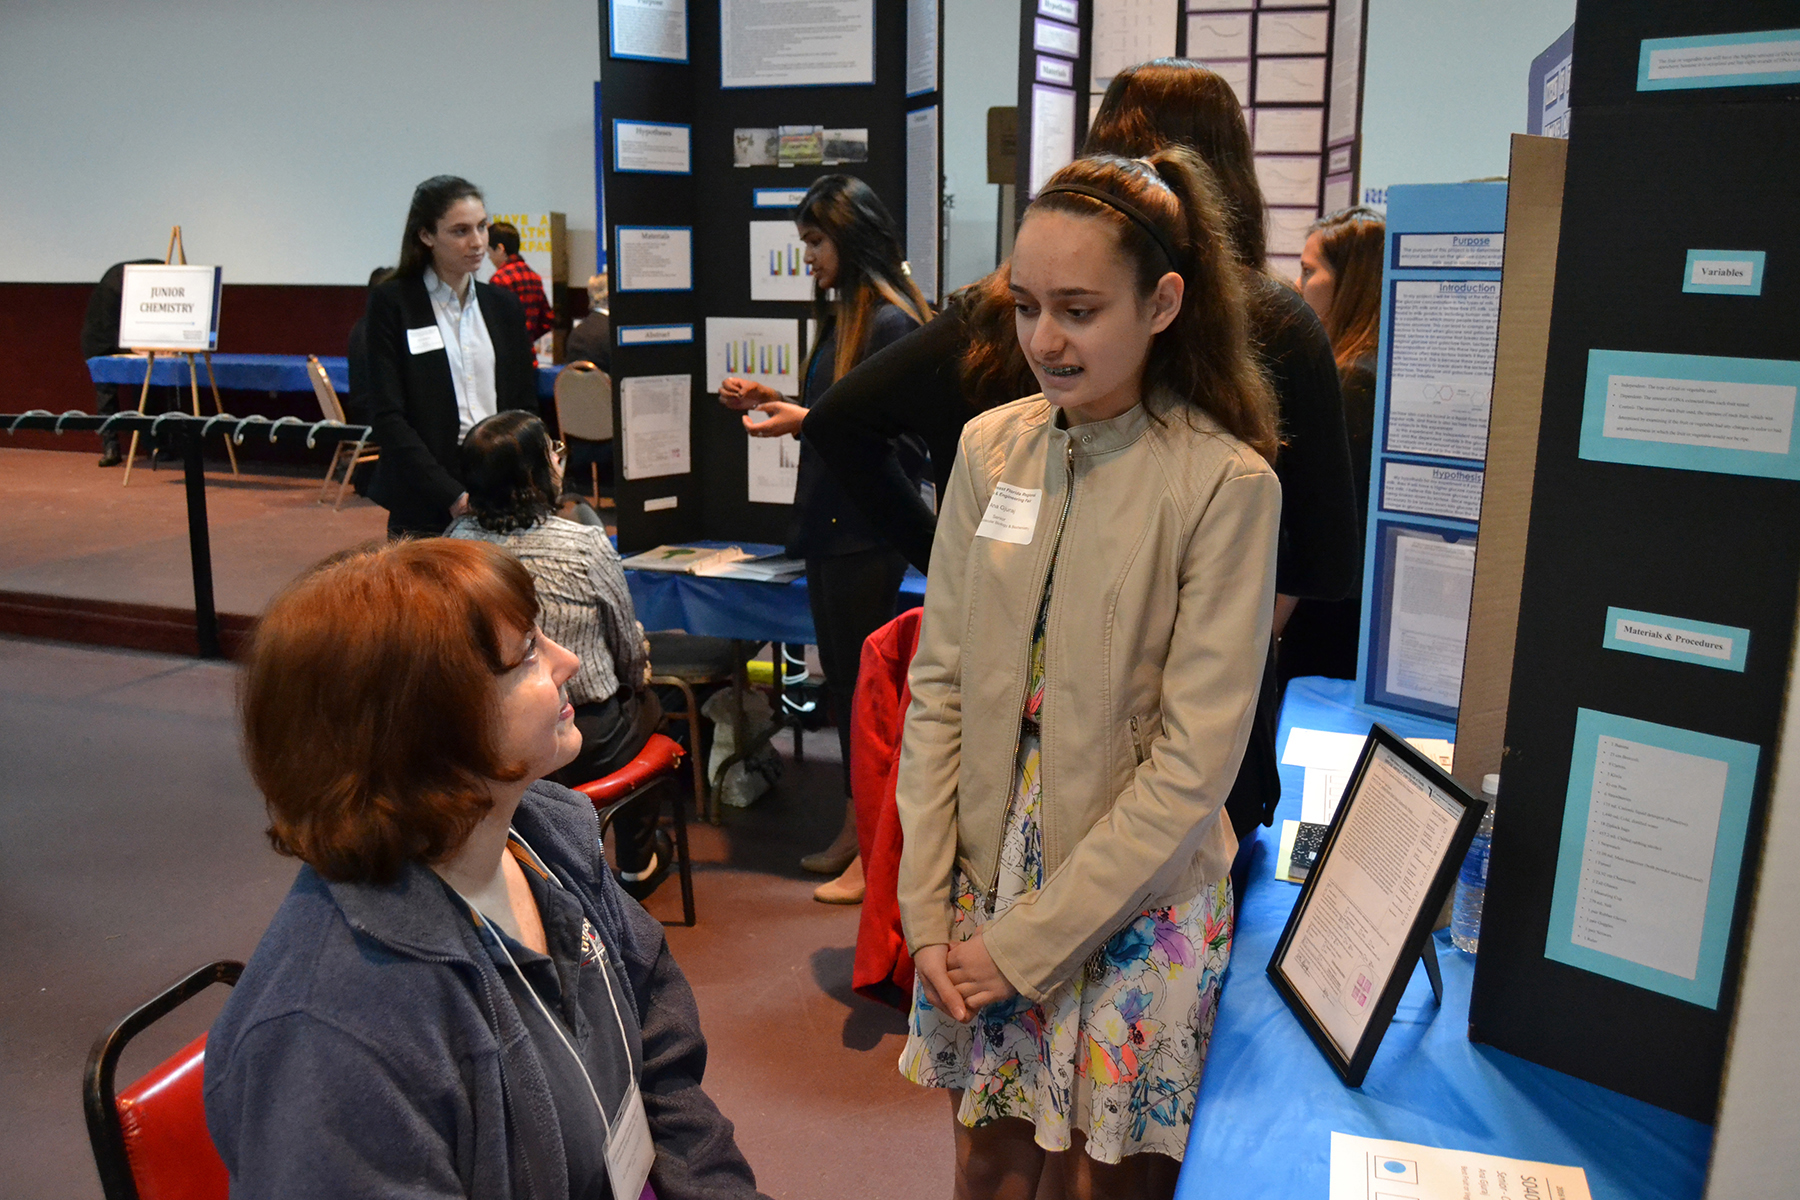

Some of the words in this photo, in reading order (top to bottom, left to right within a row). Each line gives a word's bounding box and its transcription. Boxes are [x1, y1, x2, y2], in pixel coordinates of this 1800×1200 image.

[540, 214, 549, 226] A
[1452, 236, 1490, 246] Purpose
[1702, 267, 1744, 278] Variables
[151, 287, 185, 298] JUNIOR
[1439, 284, 1496, 294] Introduction
[140, 302, 194, 314] CHEMISTRY
[1432, 468, 1482, 482] Hypothesis
[1006, 486, 1022, 496] Florida
[1624, 625, 1662, 639] Materials
[1676, 634, 1724, 650] Procedures
[1496, 1170, 1508, 1192] Senior
